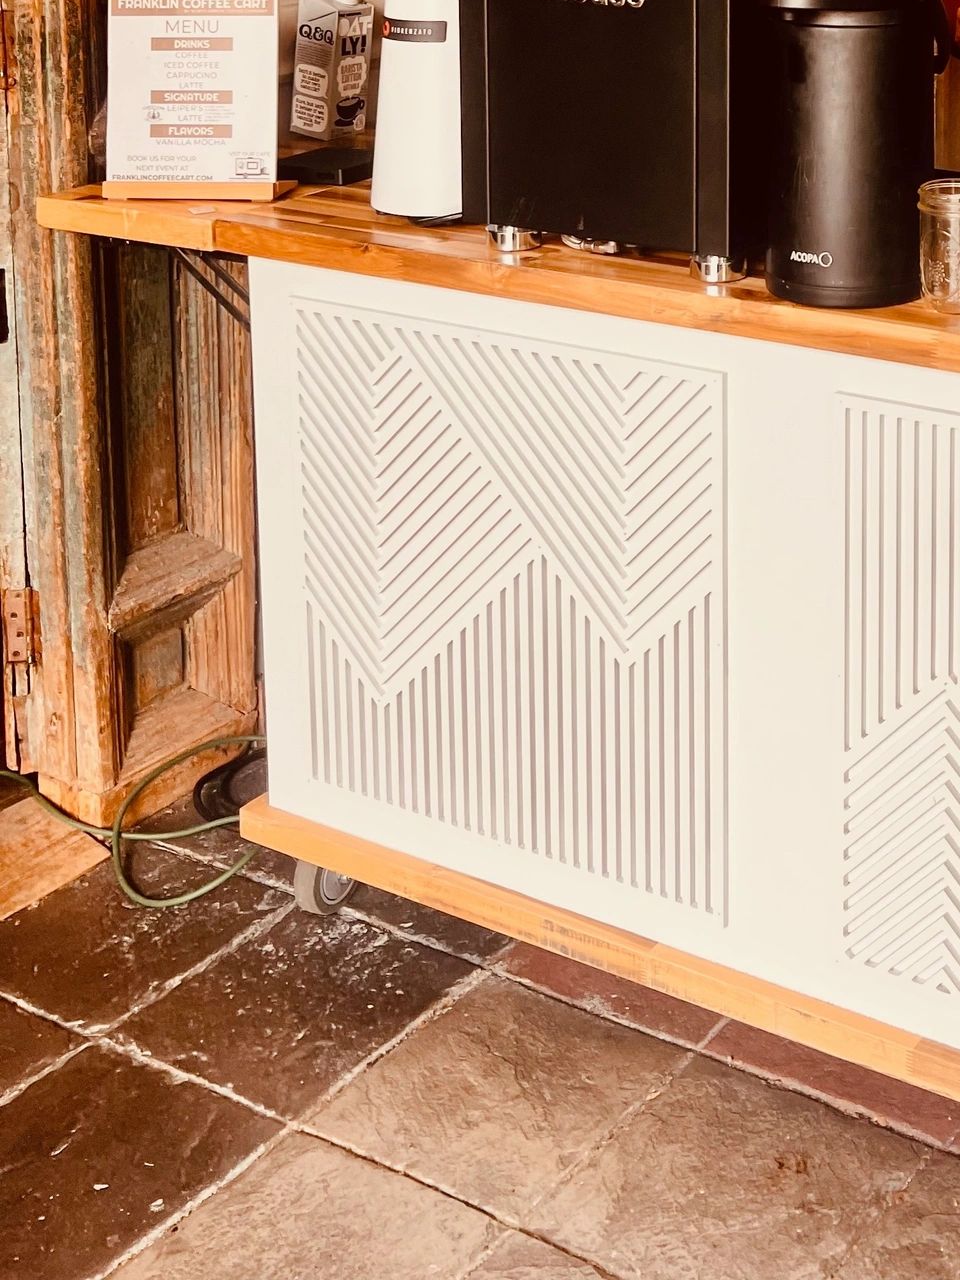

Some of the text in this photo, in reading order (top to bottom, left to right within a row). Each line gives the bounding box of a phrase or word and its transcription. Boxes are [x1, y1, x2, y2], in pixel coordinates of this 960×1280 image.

[165, 19, 220, 34] MENU
[299, 24, 334, 46] Q&Q
[174, 39, 211, 49] DRINKS
[341, 35, 367, 57] LY!
[163, 61, 220, 69] ICED COFFEE
[164, 92, 220, 102] SIGNATURE
[178, 114, 203, 122] LATTE
[168, 126, 214, 136] FLAVORS
